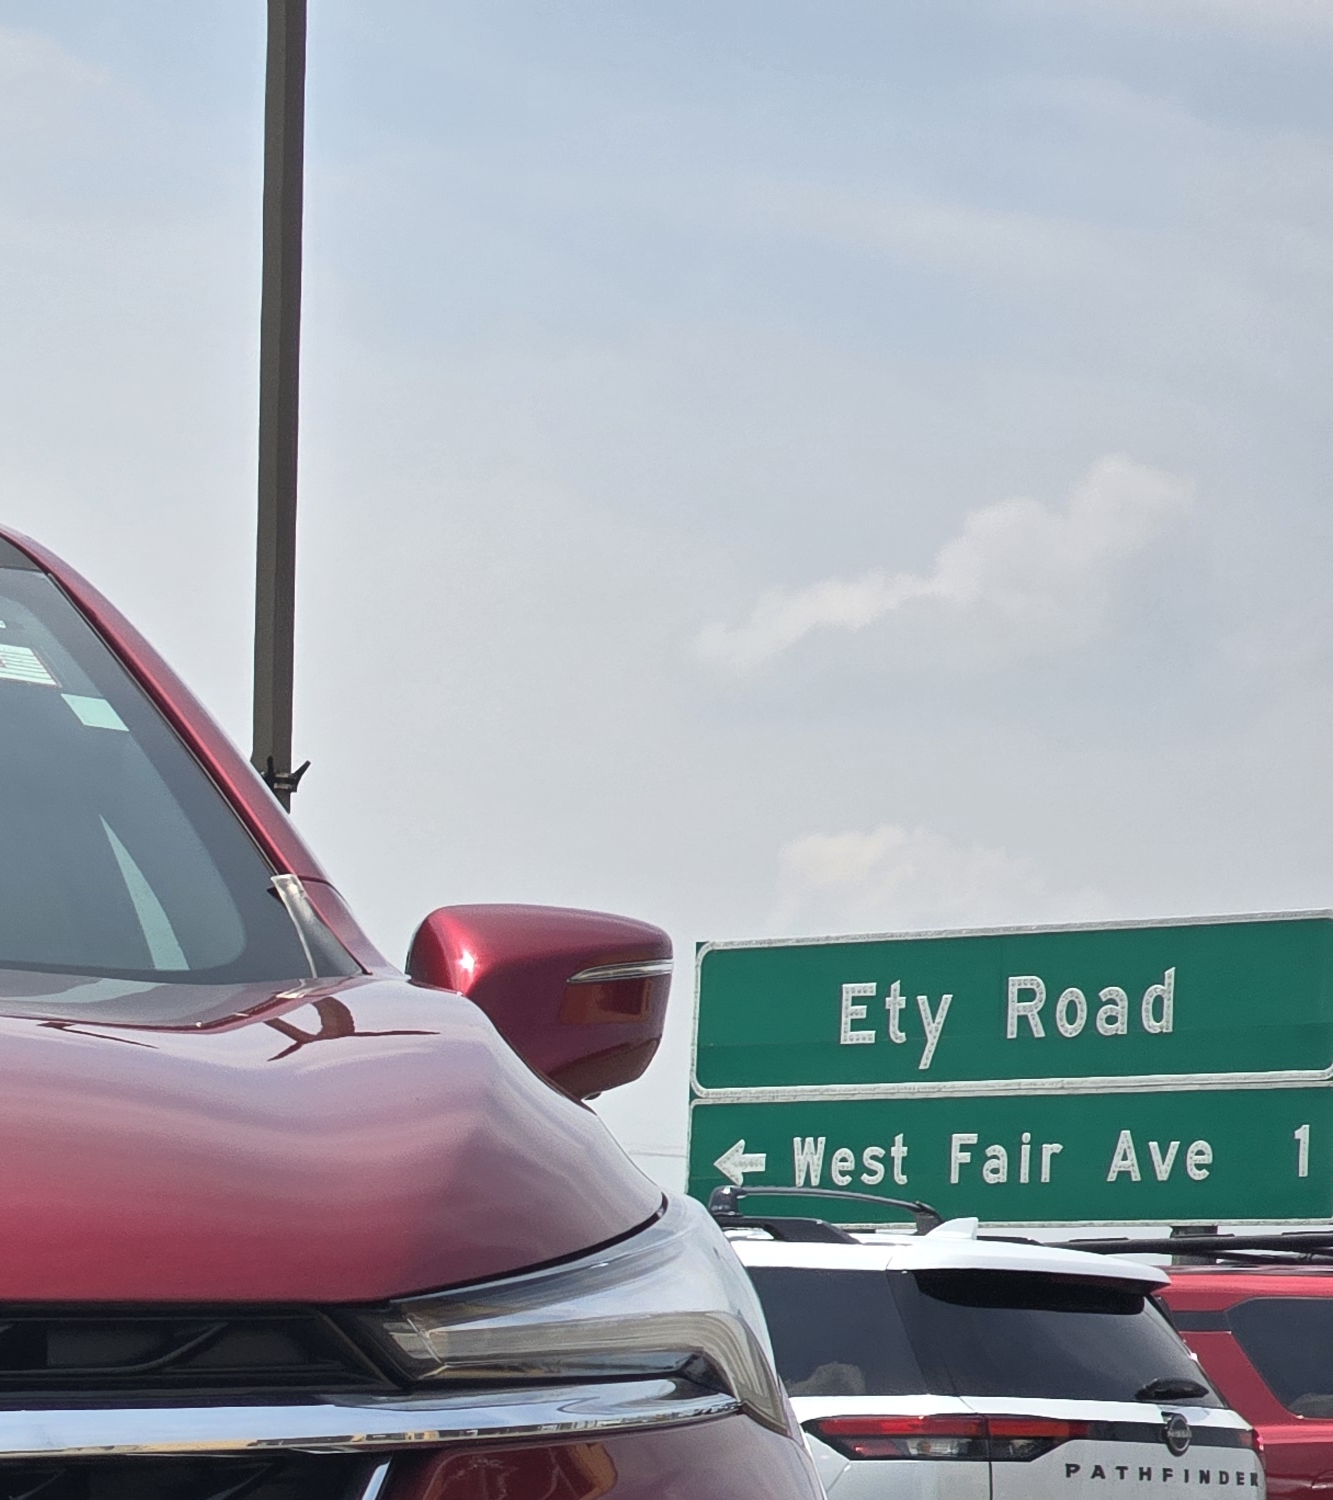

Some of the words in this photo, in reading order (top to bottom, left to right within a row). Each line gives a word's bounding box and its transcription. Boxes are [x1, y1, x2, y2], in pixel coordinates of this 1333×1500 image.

[840, 980, 954, 1070] Ety
[1006, 966, 1177, 1040] Road
[793, 1133, 909, 1188] West
[949, 1132, 1064, 1184] Fair
[1107, 1129, 1214, 1182] Ave
[1293, 1124, 1311, 1178] 1
[1065, 1463, 1259, 1487] PATHFINDER
